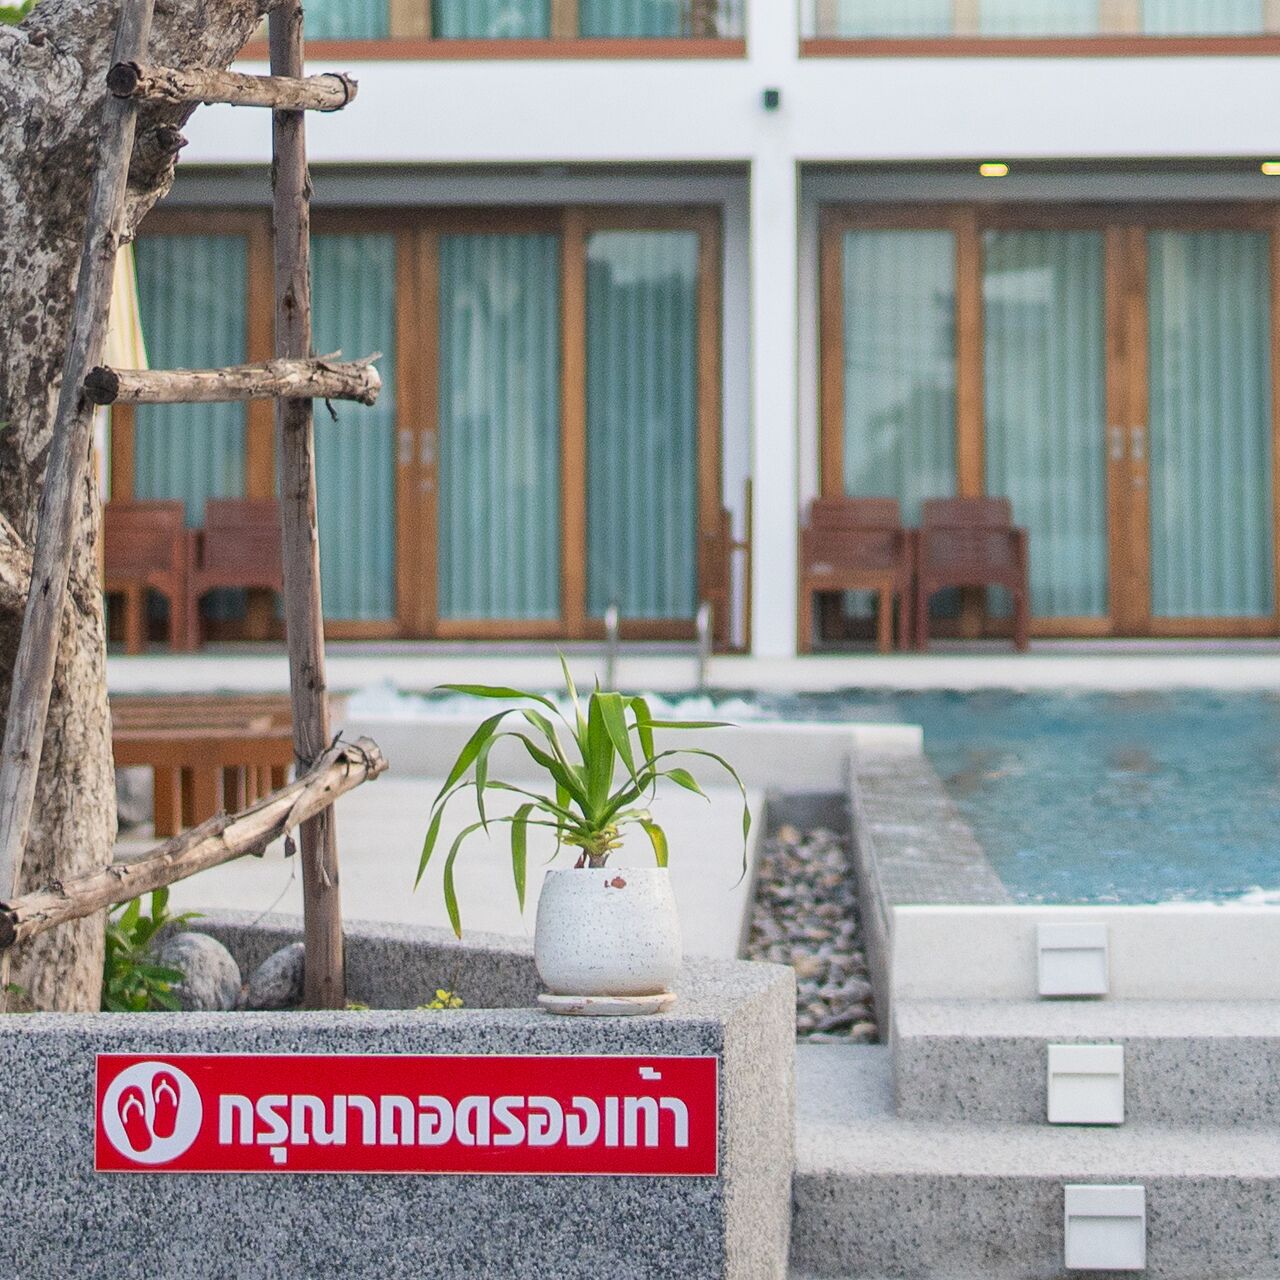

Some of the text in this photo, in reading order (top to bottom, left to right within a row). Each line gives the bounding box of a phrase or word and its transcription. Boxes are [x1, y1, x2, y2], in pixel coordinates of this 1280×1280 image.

[217, 1065, 690, 1165] กรุณาถอดรองเท้า
